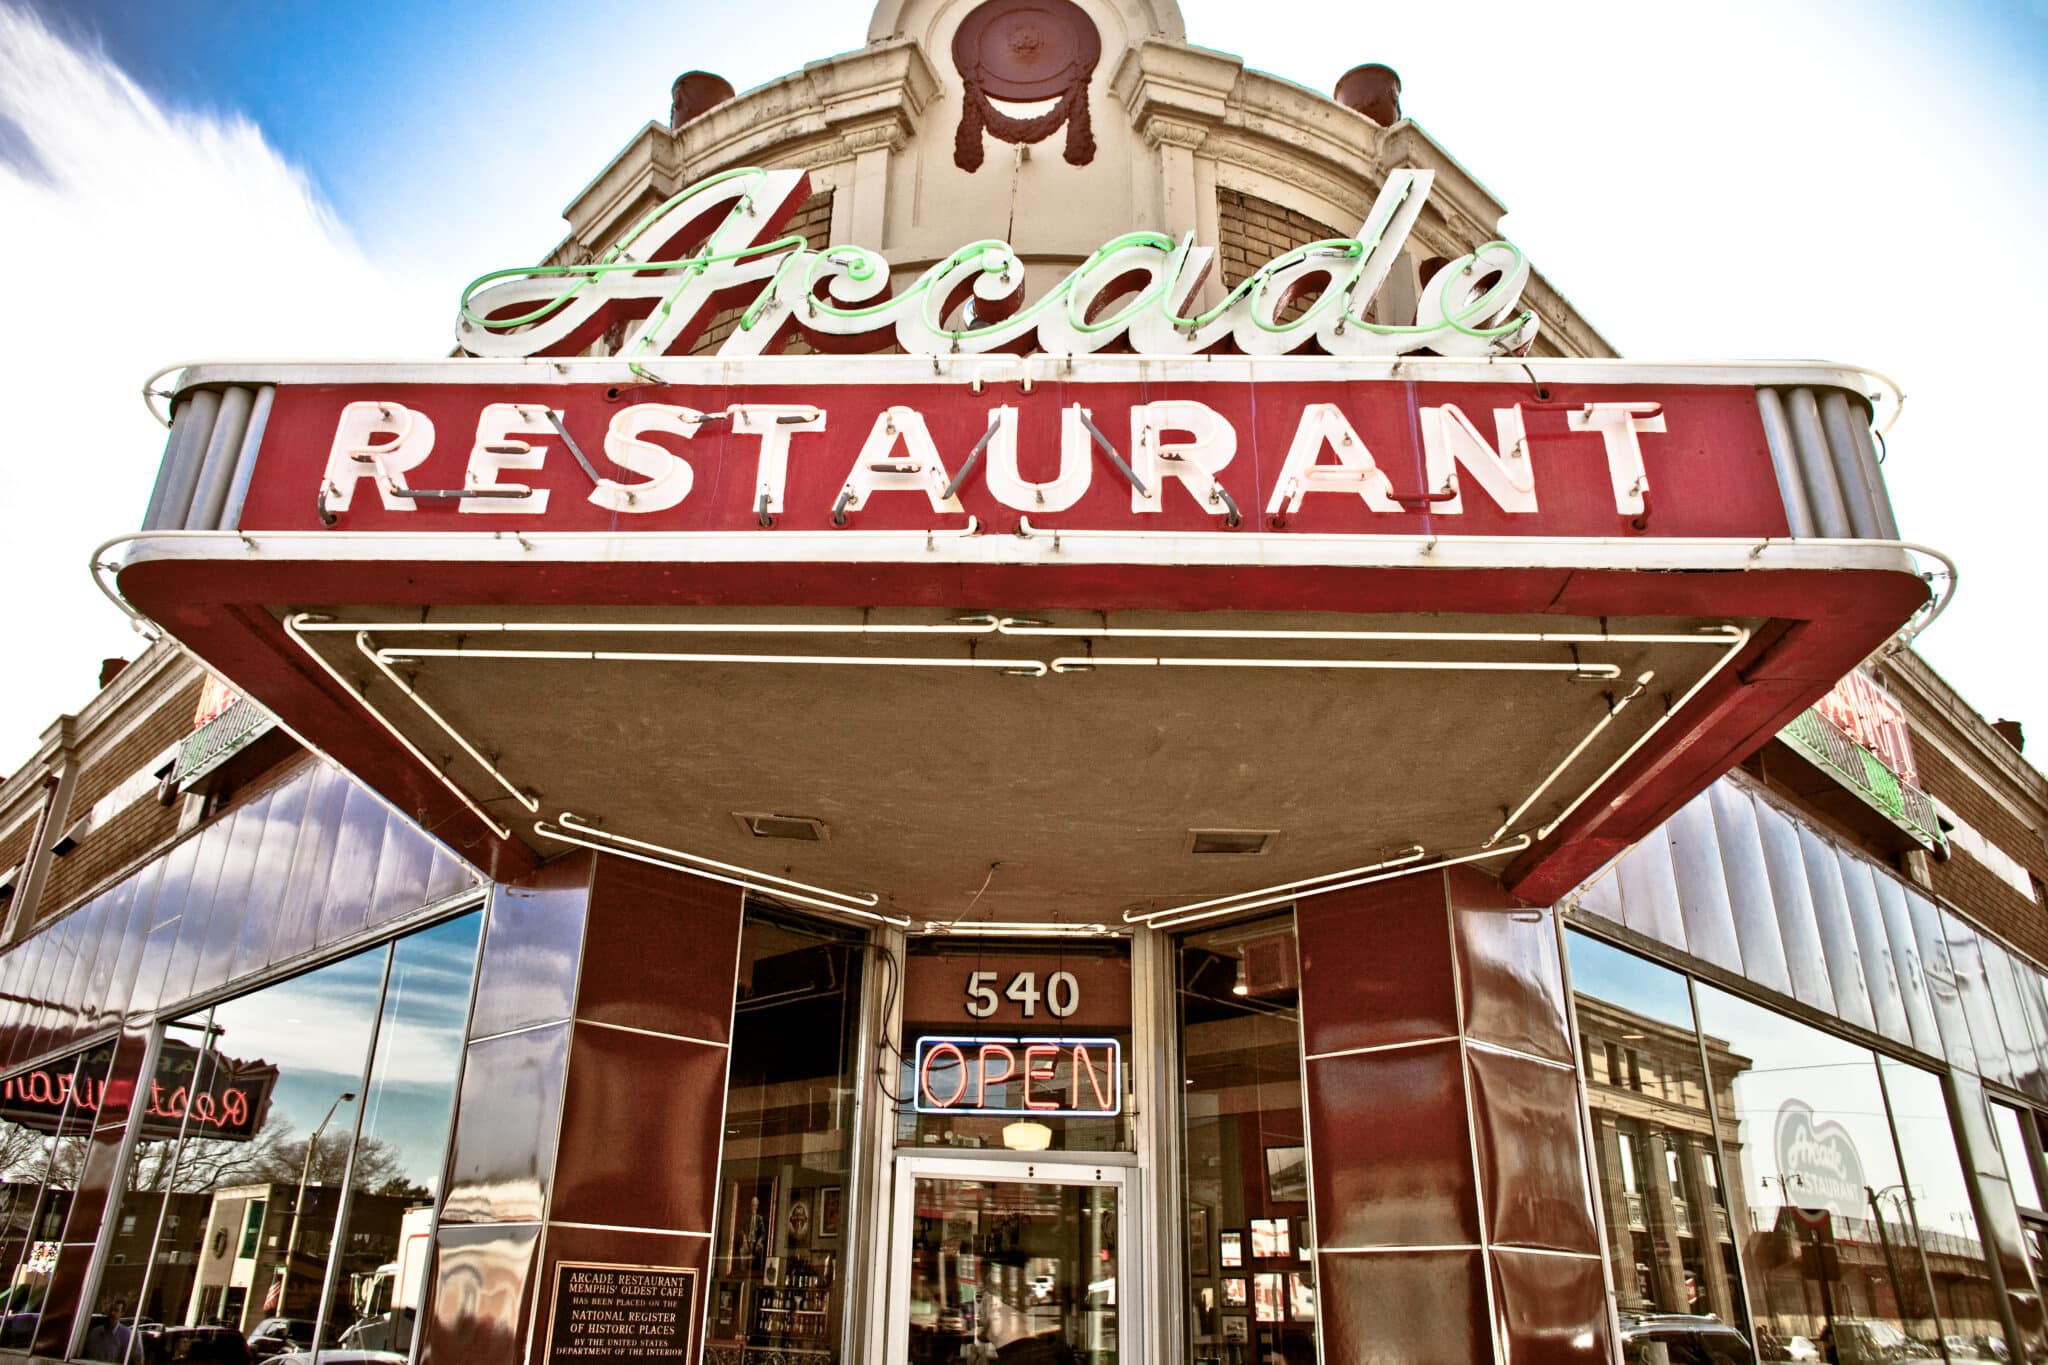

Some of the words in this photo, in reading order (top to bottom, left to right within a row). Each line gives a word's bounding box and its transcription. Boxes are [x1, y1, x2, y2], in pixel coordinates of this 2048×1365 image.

[457, 168, 1539, 357] Arcade
[318, 399, 1668, 516] RESTAURANT
[965, 971, 1080, 1018] 540
[921, 1042, 1113, 1111] OPEN
[570, 1273, 615, 1284] ARCADE
[618, 1275, 685, 1287] RESTAURANT
[569, 1283, 618, 1294] MEMPHIS'
[621, 1286, 657, 1296] OLDEST
[660, 1288, 684, 1296] CAFE
[573, 1297, 588, 1305] HAS
[592, 1298, 613, 1306] BEEN
[572, 1310, 624, 1321] NATIONAL
[628, 1312, 676, 1322] REGISTER
[570, 1324, 583, 1333] OF
[588, 1324, 635, 1334] HISTORIC
[639, 1325, 675, 1335] PLACES
[575, 1338, 585, 1346] BY
[557, 1347, 611, 1355] DEPARTMENT
